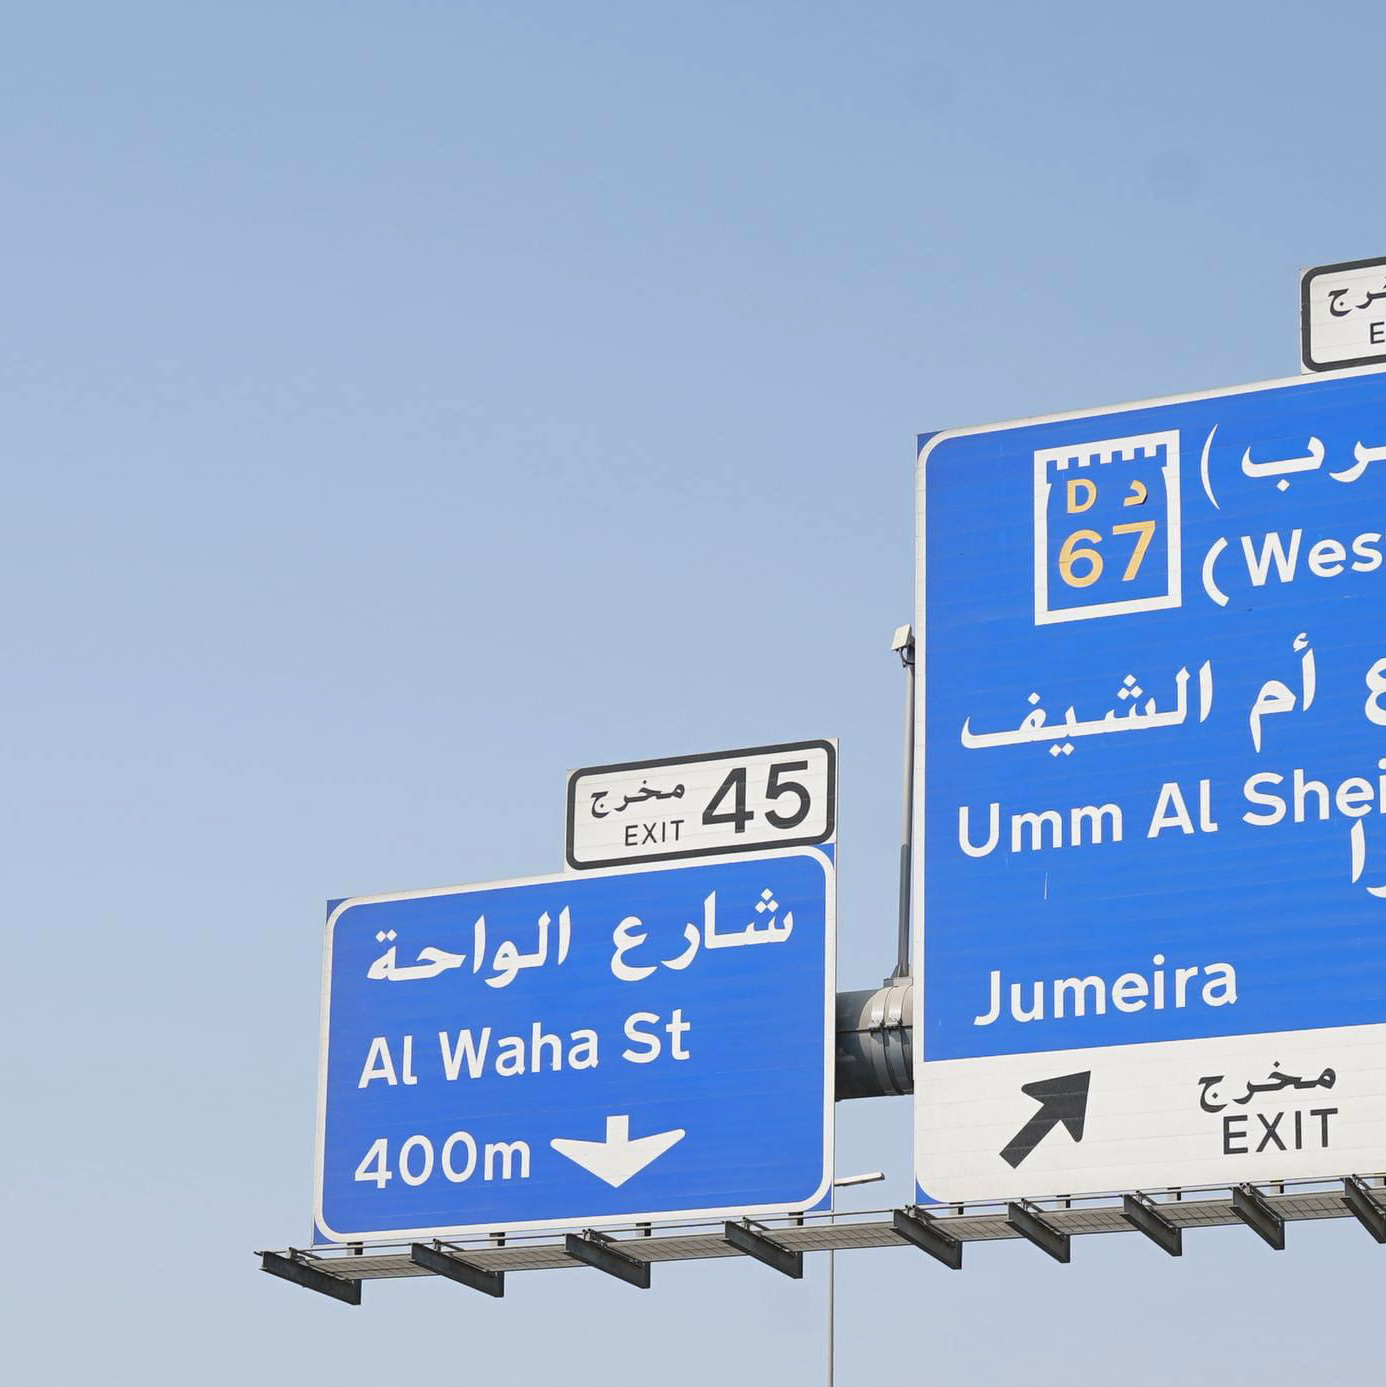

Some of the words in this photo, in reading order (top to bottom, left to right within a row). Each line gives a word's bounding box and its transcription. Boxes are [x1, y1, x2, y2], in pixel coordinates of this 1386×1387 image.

[1066, 477, 1097, 514] D
[1122, 478, 1149, 507] د
[1058, 519, 1157, 589] 67
[960, 658, 1213, 758] الشيف
[1249, 631, 1316, 754] أم
[589, 778, 687, 820] مخرج
[623, 818, 686, 848] EXIT
[701, 758, 813, 835] 45
[958, 800, 1123, 859] Umm
[1146, 778, 1218, 839] Al
[366, 904, 572, 989] الواحة
[610, 886, 795, 983] شارع
[972, 952, 1239, 1027] Jumeira
[357, 1033, 418, 1090] Al
[438, 1020, 600, 1083] Waha
[621, 1007, 693, 1065] St
[1197, 1058, 1339, 1113] مخرج
[353, 1129, 532, 1190] 400m
[1222, 1107, 1340, 1156] EXIT
